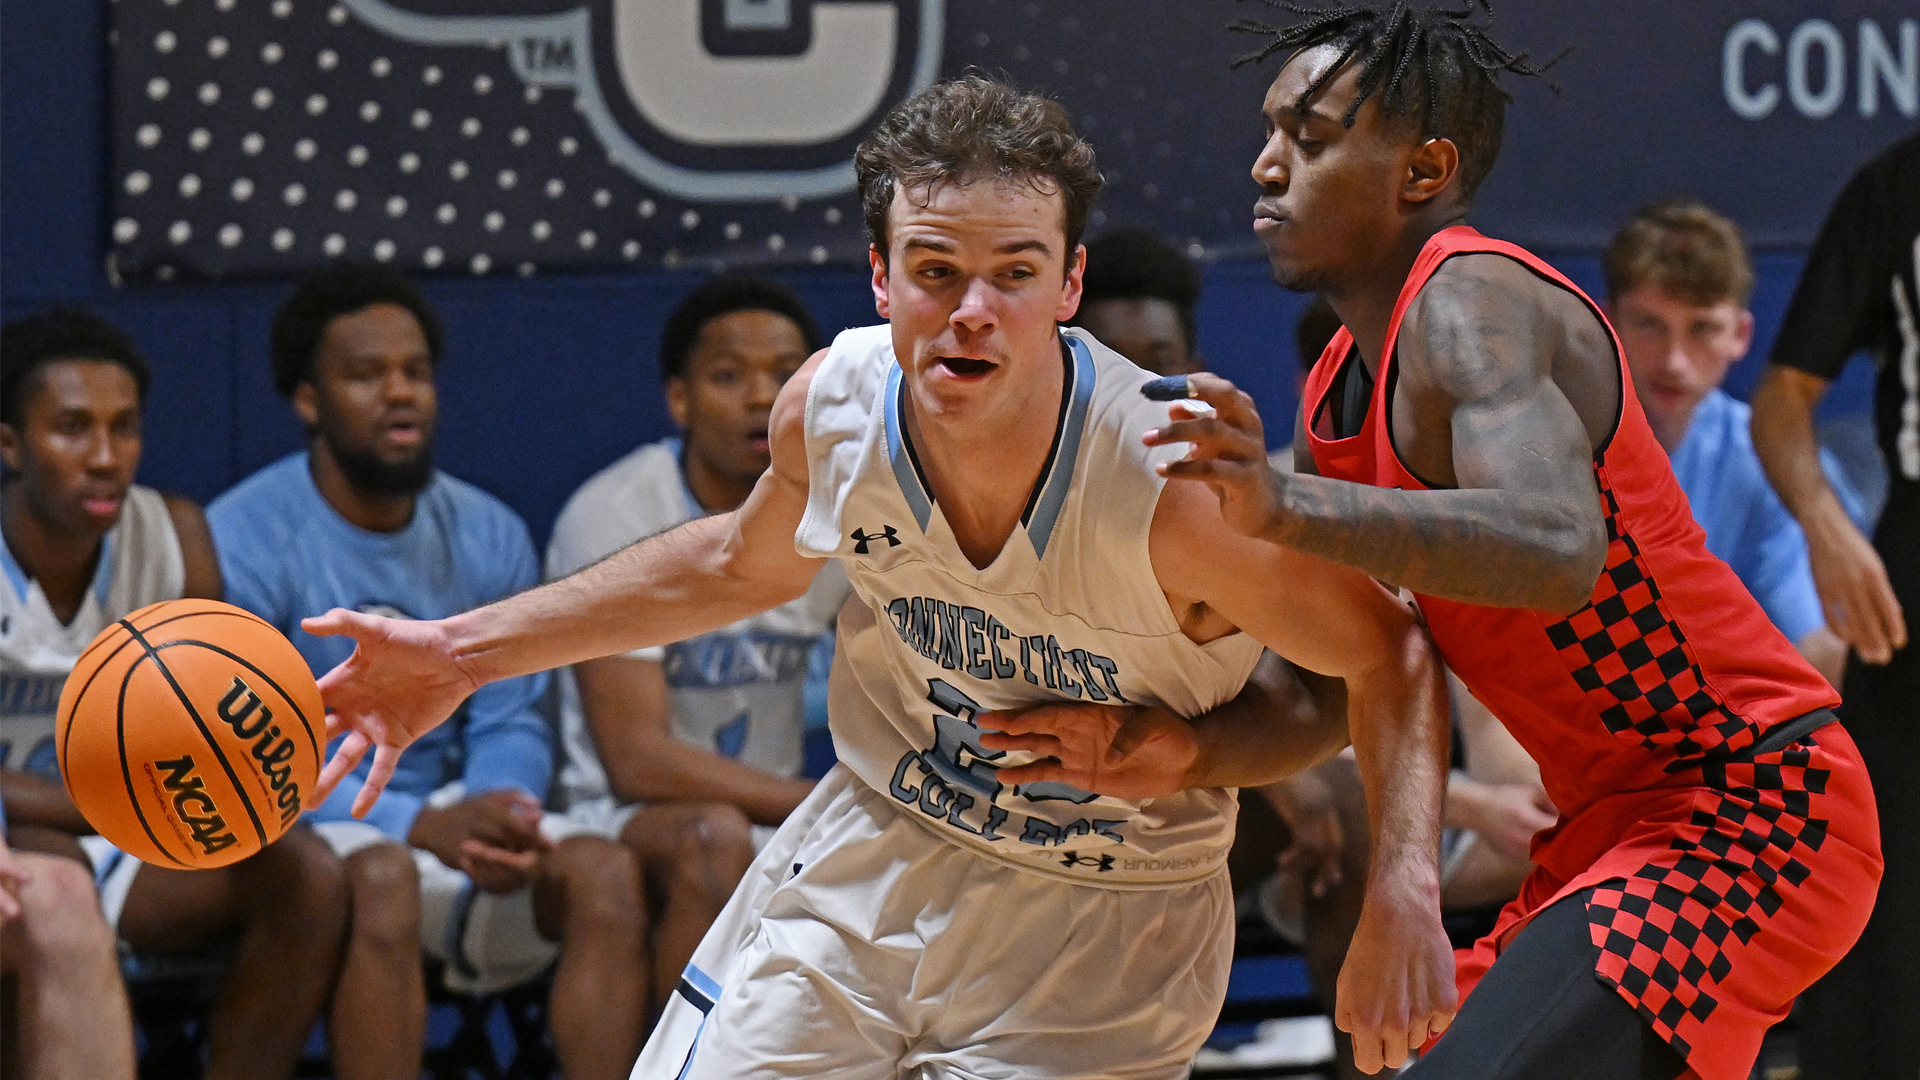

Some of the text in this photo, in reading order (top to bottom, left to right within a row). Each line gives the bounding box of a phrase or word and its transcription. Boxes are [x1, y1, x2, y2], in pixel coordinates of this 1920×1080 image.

[522, 37, 576, 70] TM
[1721, 17, 1920, 120] CON
[884, 596, 1128, 703] ONNECTICUT
[217, 673, 301, 831] Wilson
[153, 754, 239, 856] NCAA
[1122, 857, 1200, 872] ARMOUR
